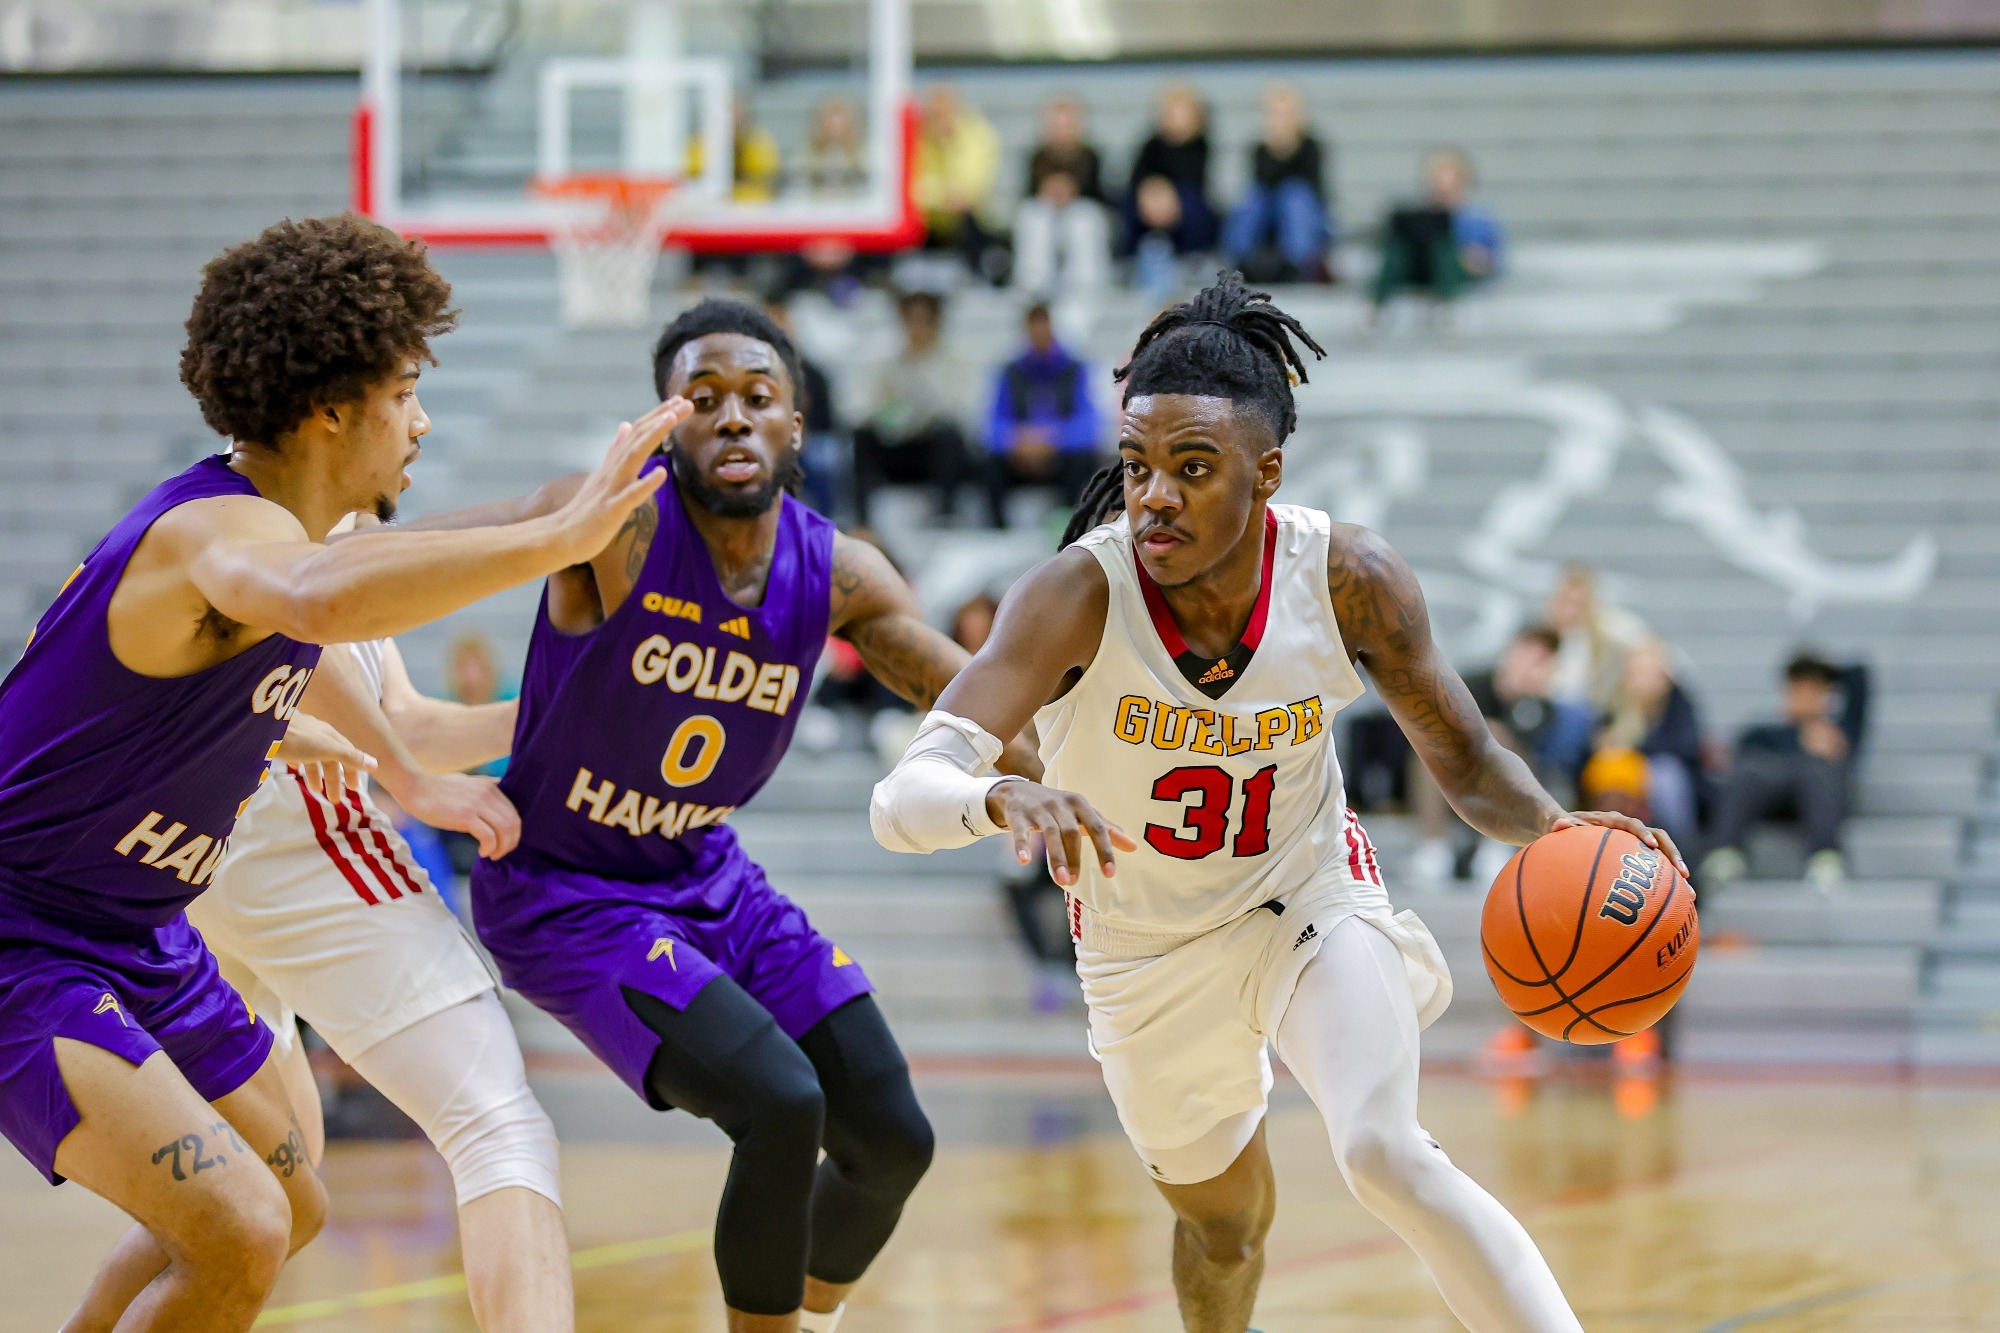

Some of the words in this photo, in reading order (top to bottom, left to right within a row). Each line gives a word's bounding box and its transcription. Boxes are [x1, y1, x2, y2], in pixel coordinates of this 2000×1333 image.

[643, 591, 702, 623] OUA
[252, 664, 313, 721] GOL
[1198, 669, 1234, 684] adidas
[661, 714, 726, 788] 0
[1114, 695, 1323, 757] GUELPH
[566, 766, 735, 840] HAWK
[1144, 763, 1278, 860] 31
[114, 810, 231, 886] HAW
[1598, 841, 1660, 927] Wils
